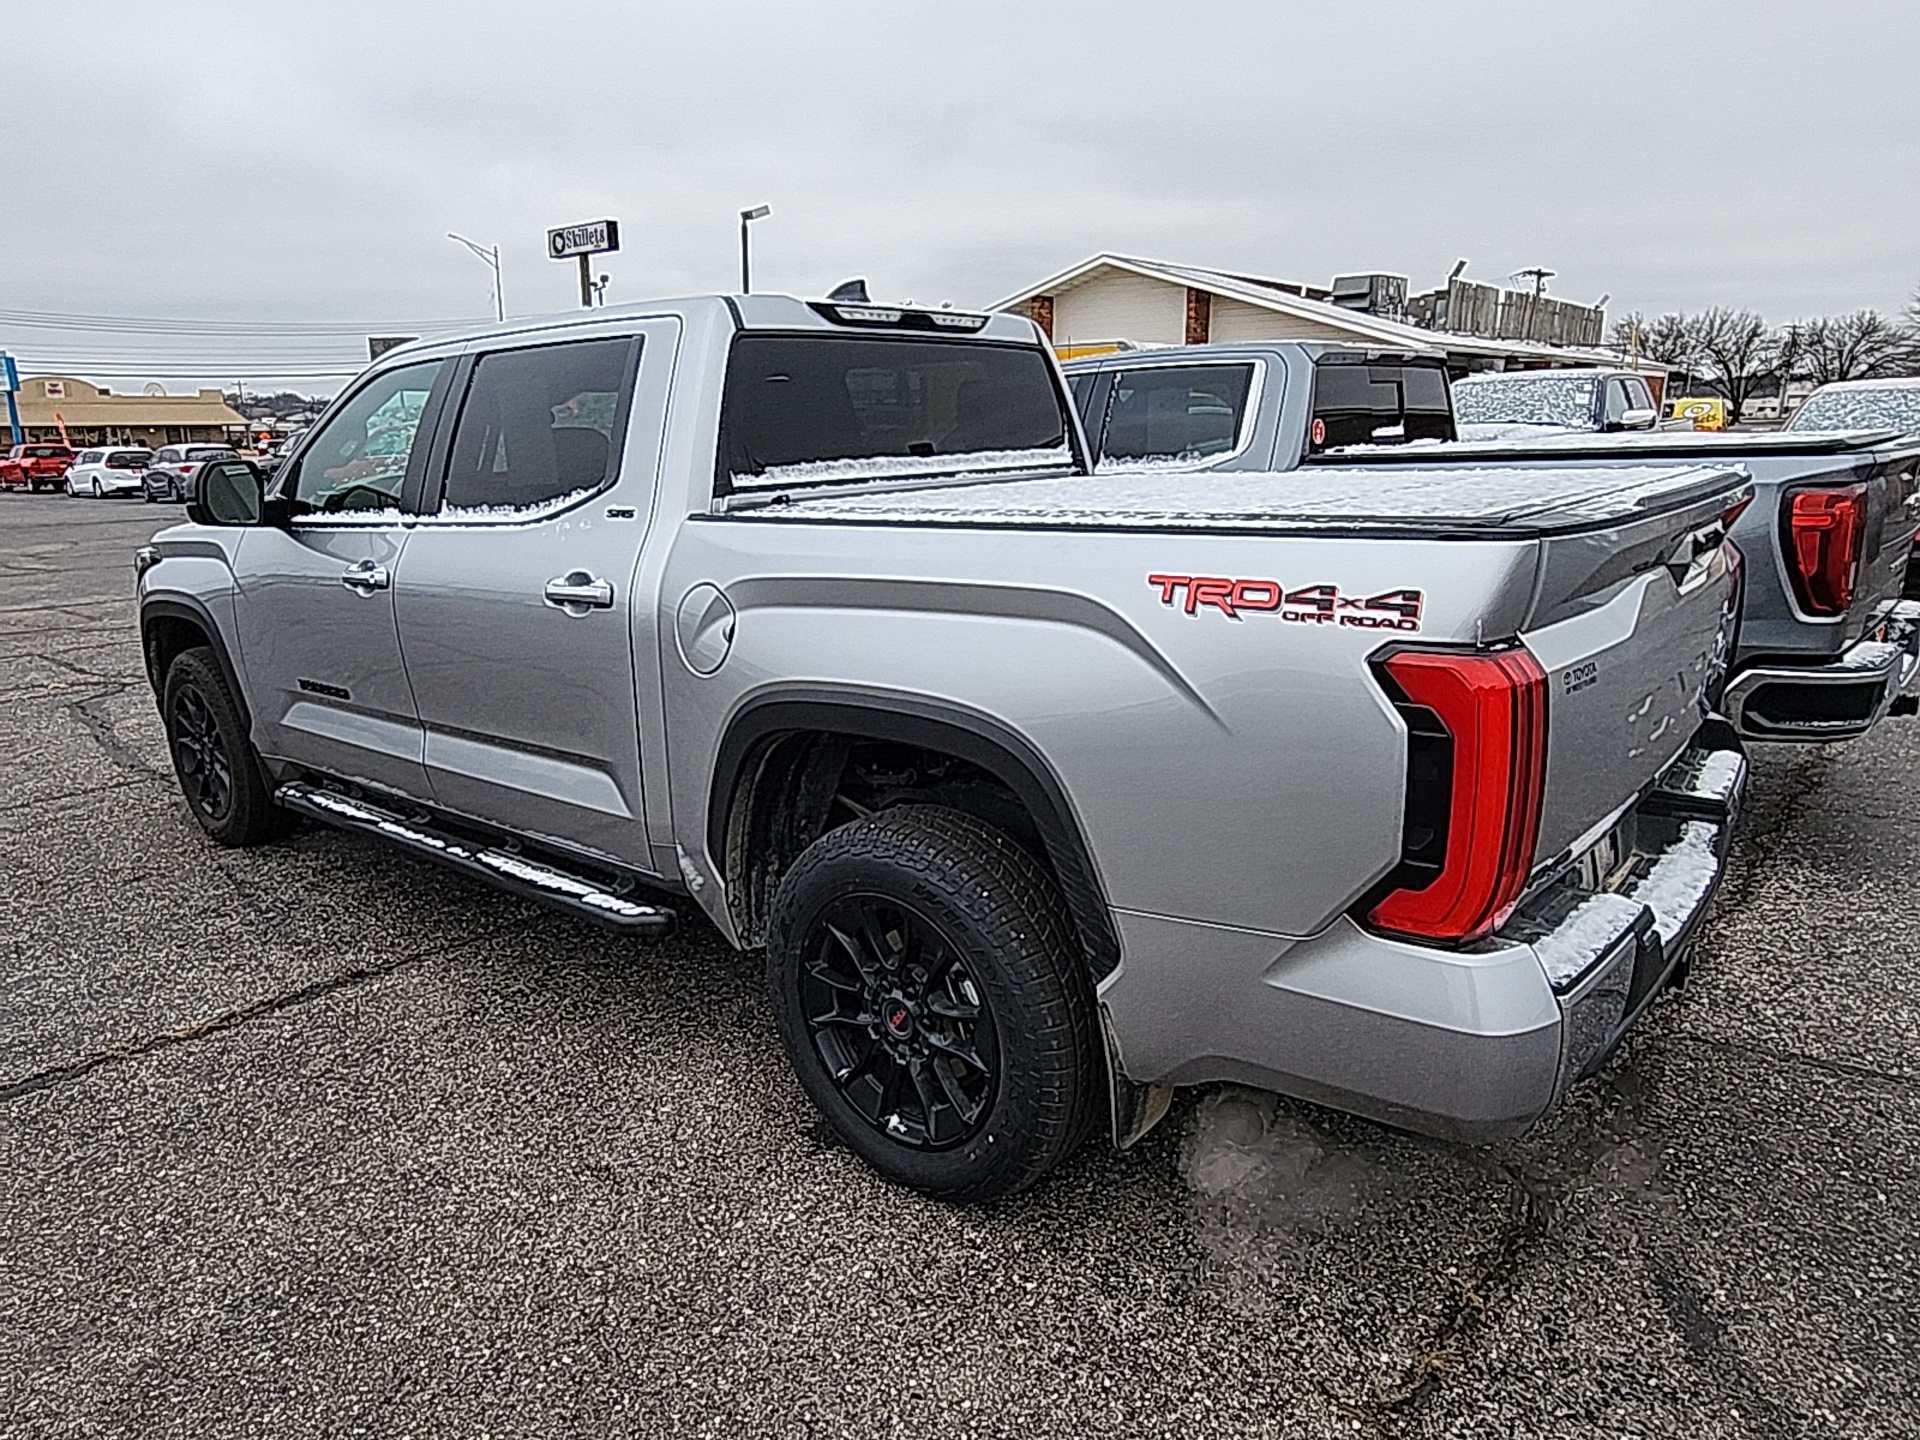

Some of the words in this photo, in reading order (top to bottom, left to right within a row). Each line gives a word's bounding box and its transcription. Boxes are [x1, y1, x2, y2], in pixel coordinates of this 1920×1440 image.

[565, 227, 605, 249] Skillets
[1149, 575, 1284, 621] TRD
[1282, 611, 1335, 624] OFF
[1339, 615, 1420, 632] ROAD
